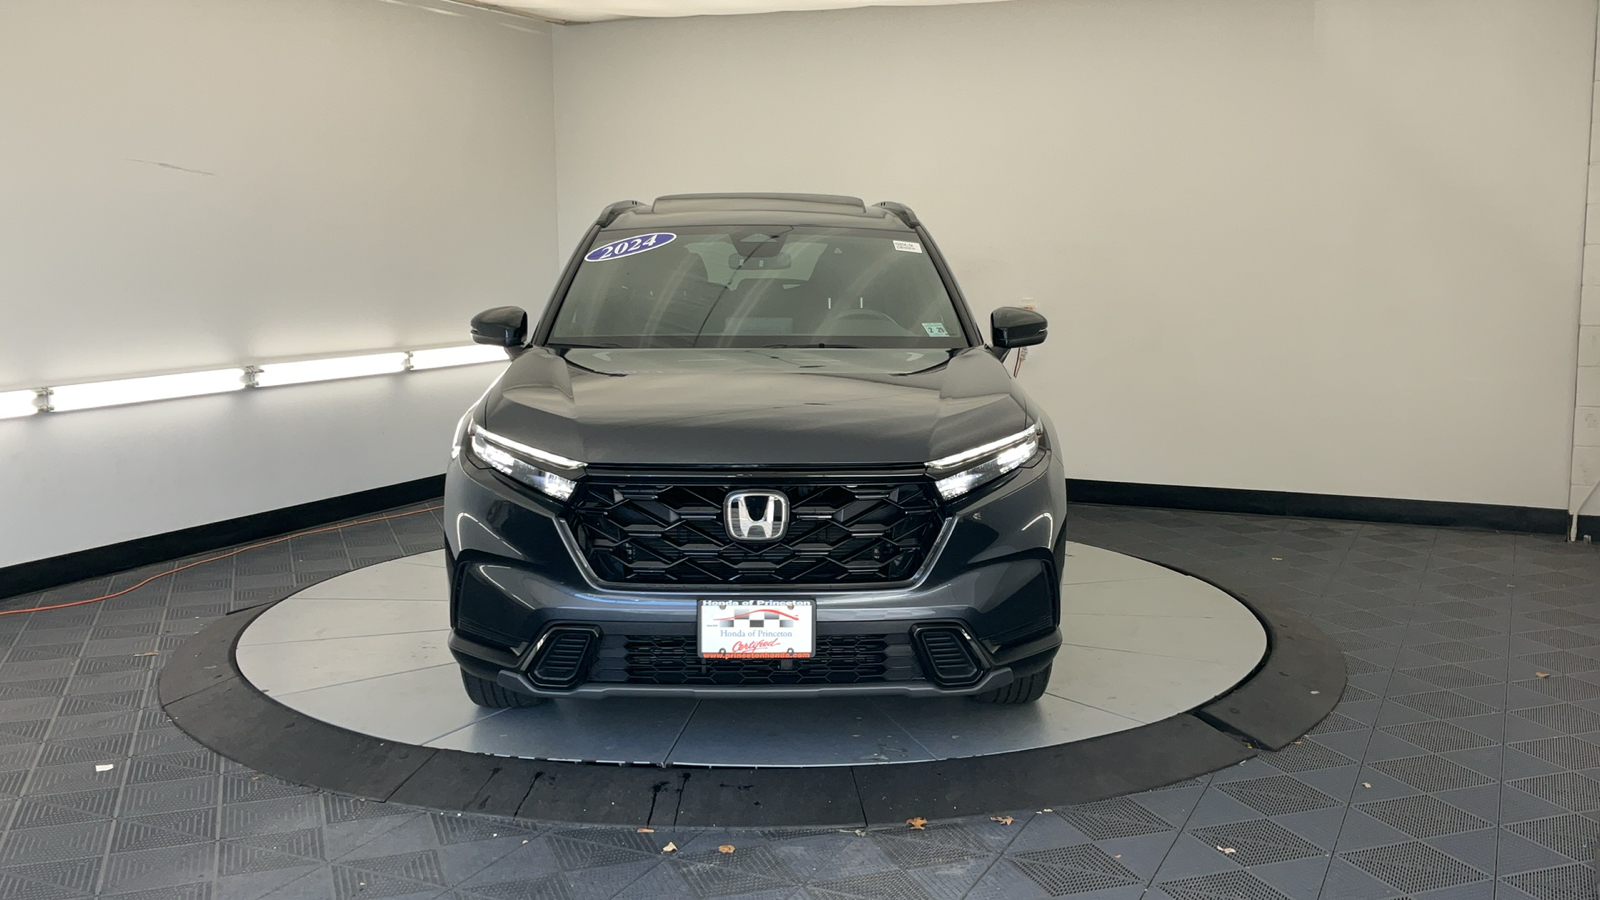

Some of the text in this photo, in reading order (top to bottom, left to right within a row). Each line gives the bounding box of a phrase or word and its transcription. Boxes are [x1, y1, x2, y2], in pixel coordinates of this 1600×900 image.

[600, 234, 658, 259] 2024
[720, 629, 793, 637] Honda of Princeton
[732, 638, 781, 653] Certified
[703, 652, 811, 660] www.princetonhonda.com
